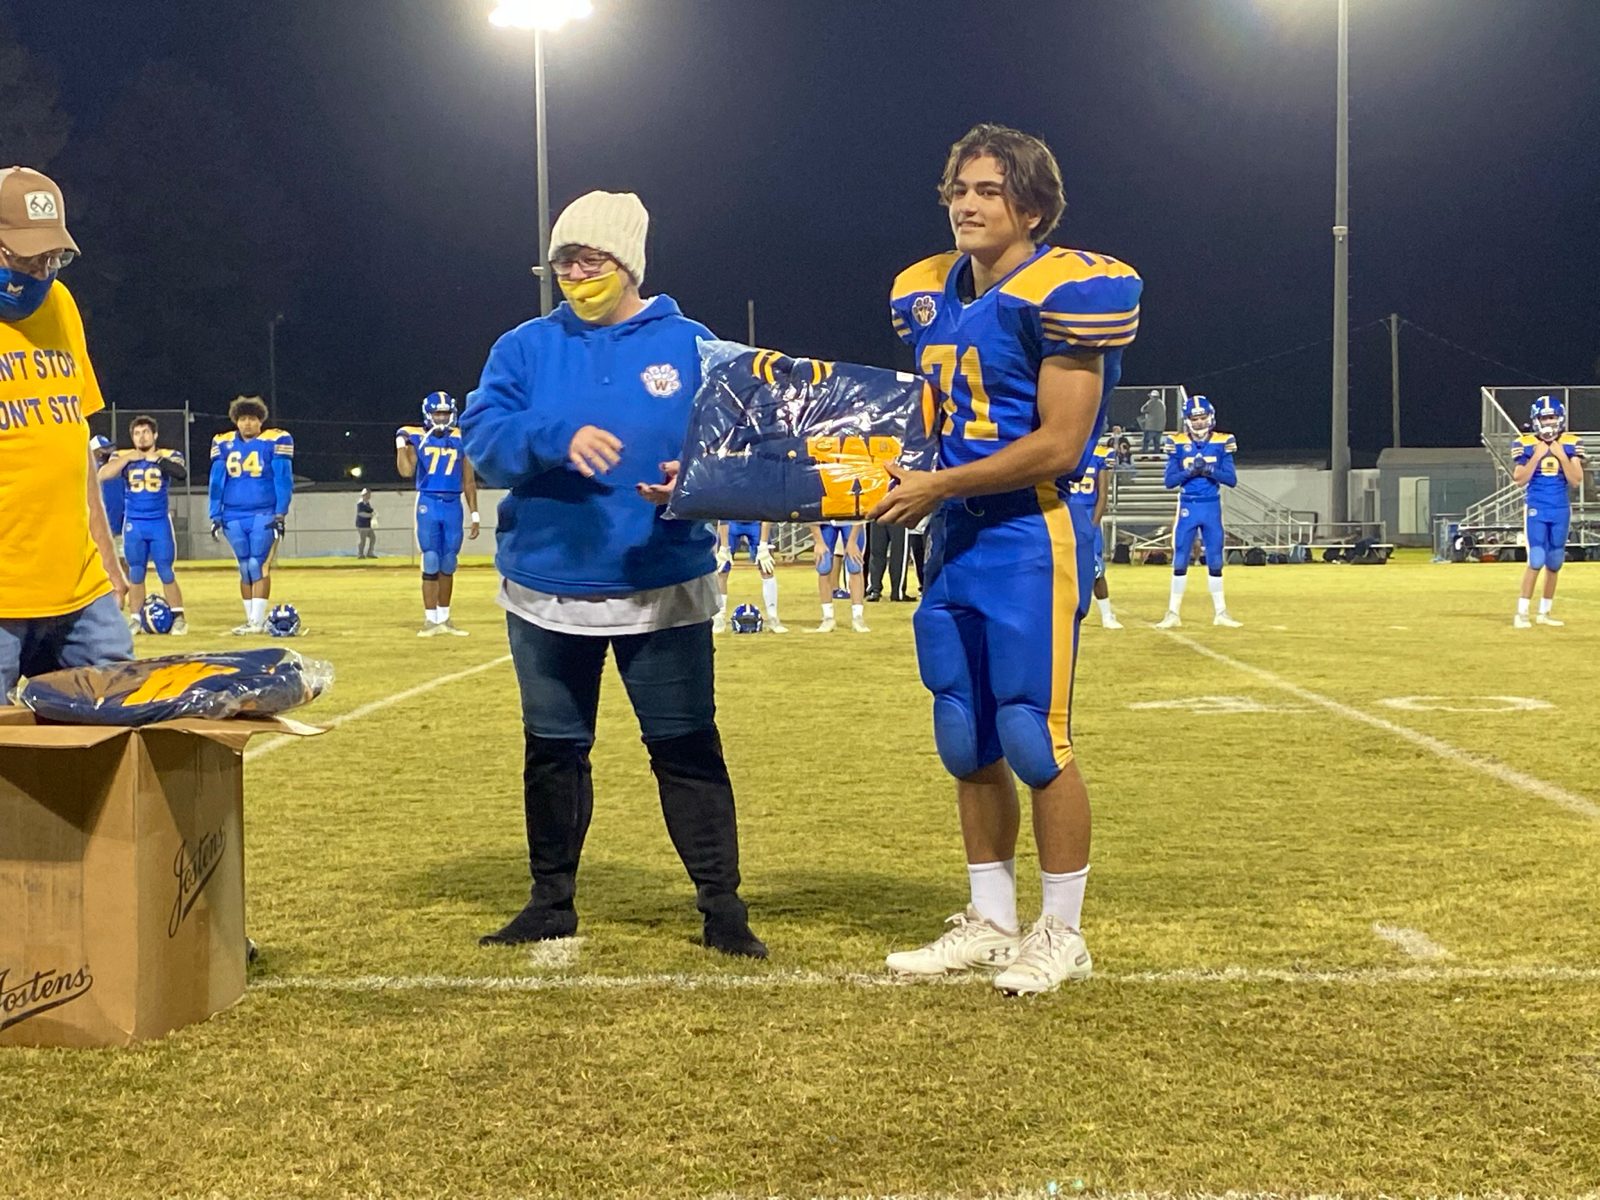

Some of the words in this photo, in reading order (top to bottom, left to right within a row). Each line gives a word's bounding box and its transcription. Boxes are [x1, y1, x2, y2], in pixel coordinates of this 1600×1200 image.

[654, 379, 669, 391] W
[920, 344, 999, 441] 71
[226, 450, 263, 478] 64
[424, 446, 458, 475] 77
[128, 467, 162, 493] 56
[168, 820, 227, 938] Jostens
